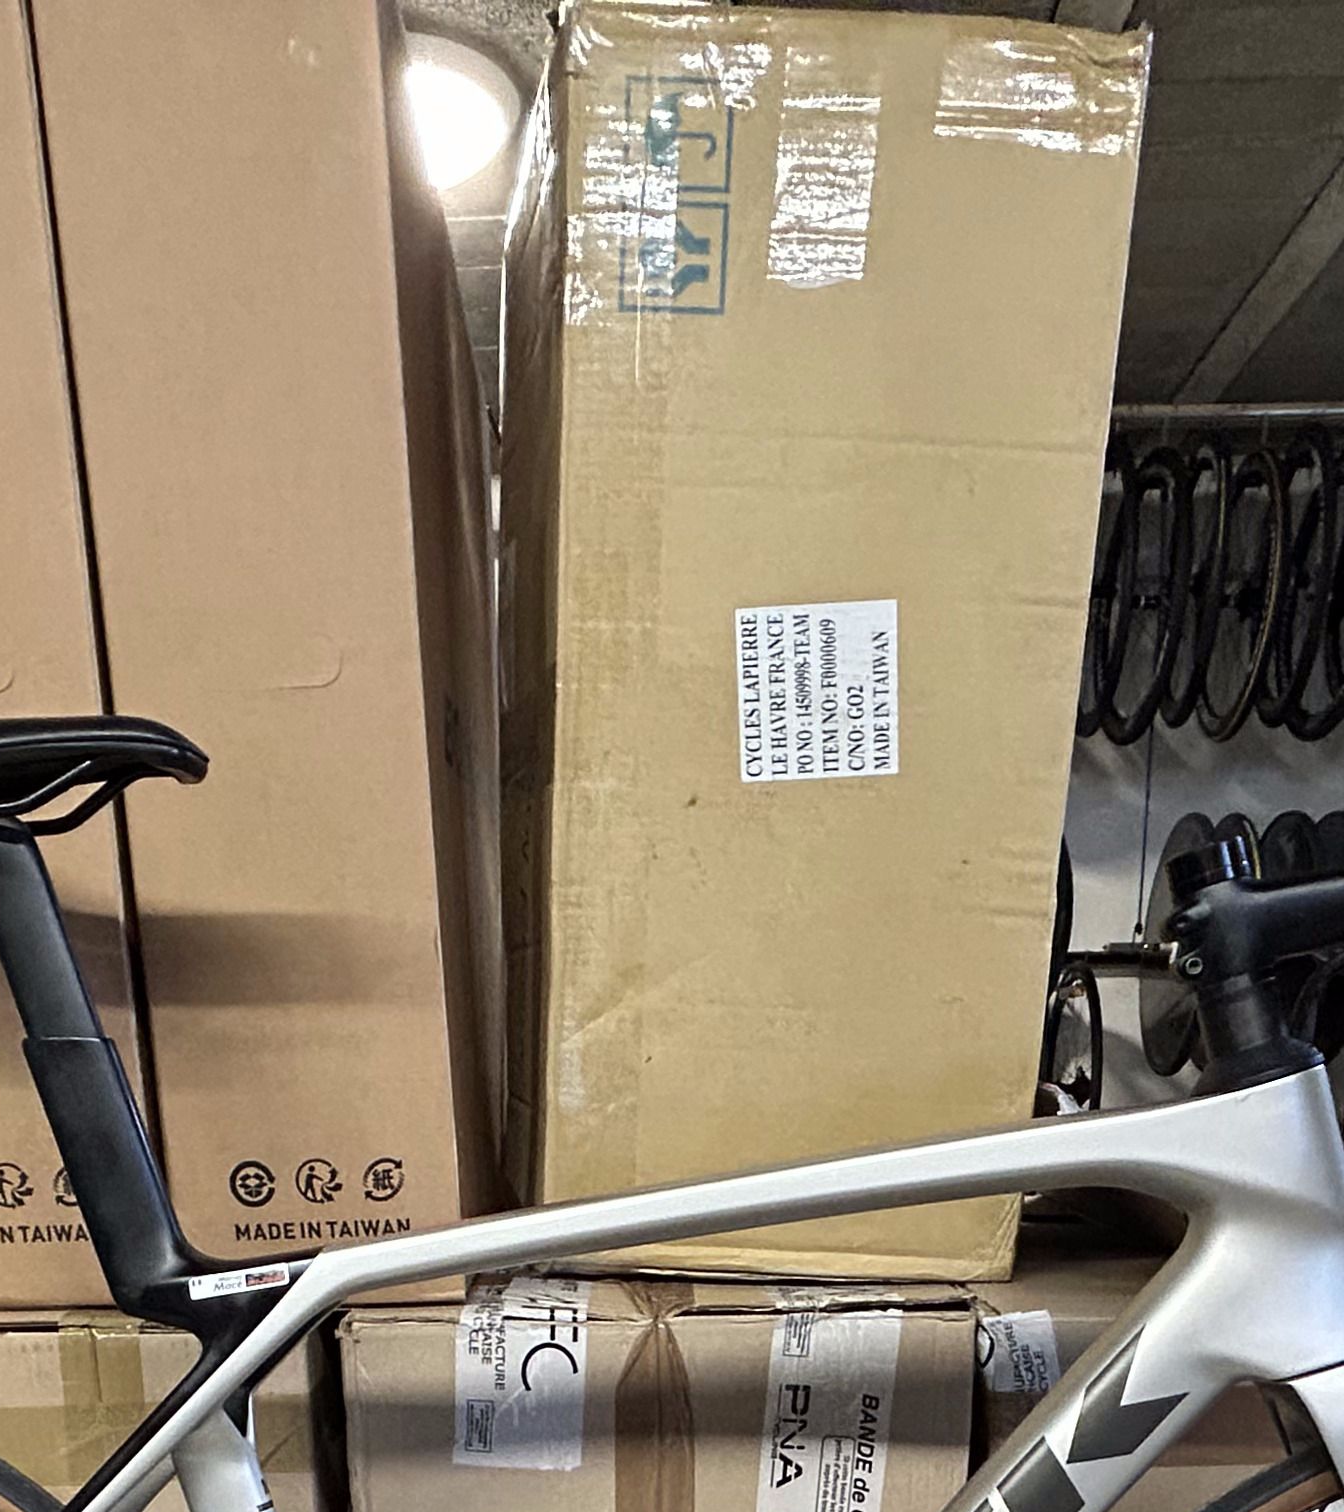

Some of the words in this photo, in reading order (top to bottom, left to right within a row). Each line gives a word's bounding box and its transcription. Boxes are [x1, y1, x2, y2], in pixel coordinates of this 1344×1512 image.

[741, 614, 761, 703] LAPIERRE
[767, 613, 785, 684] FRANCE
[872, 631, 889, 697] TAIWAN
[769, 690, 787, 748] HAVRE
[821, 693, 838, 725] NO:
[873, 702, 890, 718] IN
[744, 709, 763, 777] CYCLES
[771, 753, 788, 775] LE
[797, 755, 814, 774] PO
[823, 729, 839, 772] ITEM
[848, 724, 865, 771] C/NO:
[873, 722, 890, 769] MADE
[17, 1224, 90, 1243] TAIWA
[235, 1222, 296, 1242] MADE
[300, 1221, 323, 1240] IN
[327, 1218, 411, 1239] TAIWAN
[855, 1394, 880, 1474] BANDE
[852, 1478, 870, 1503] de
